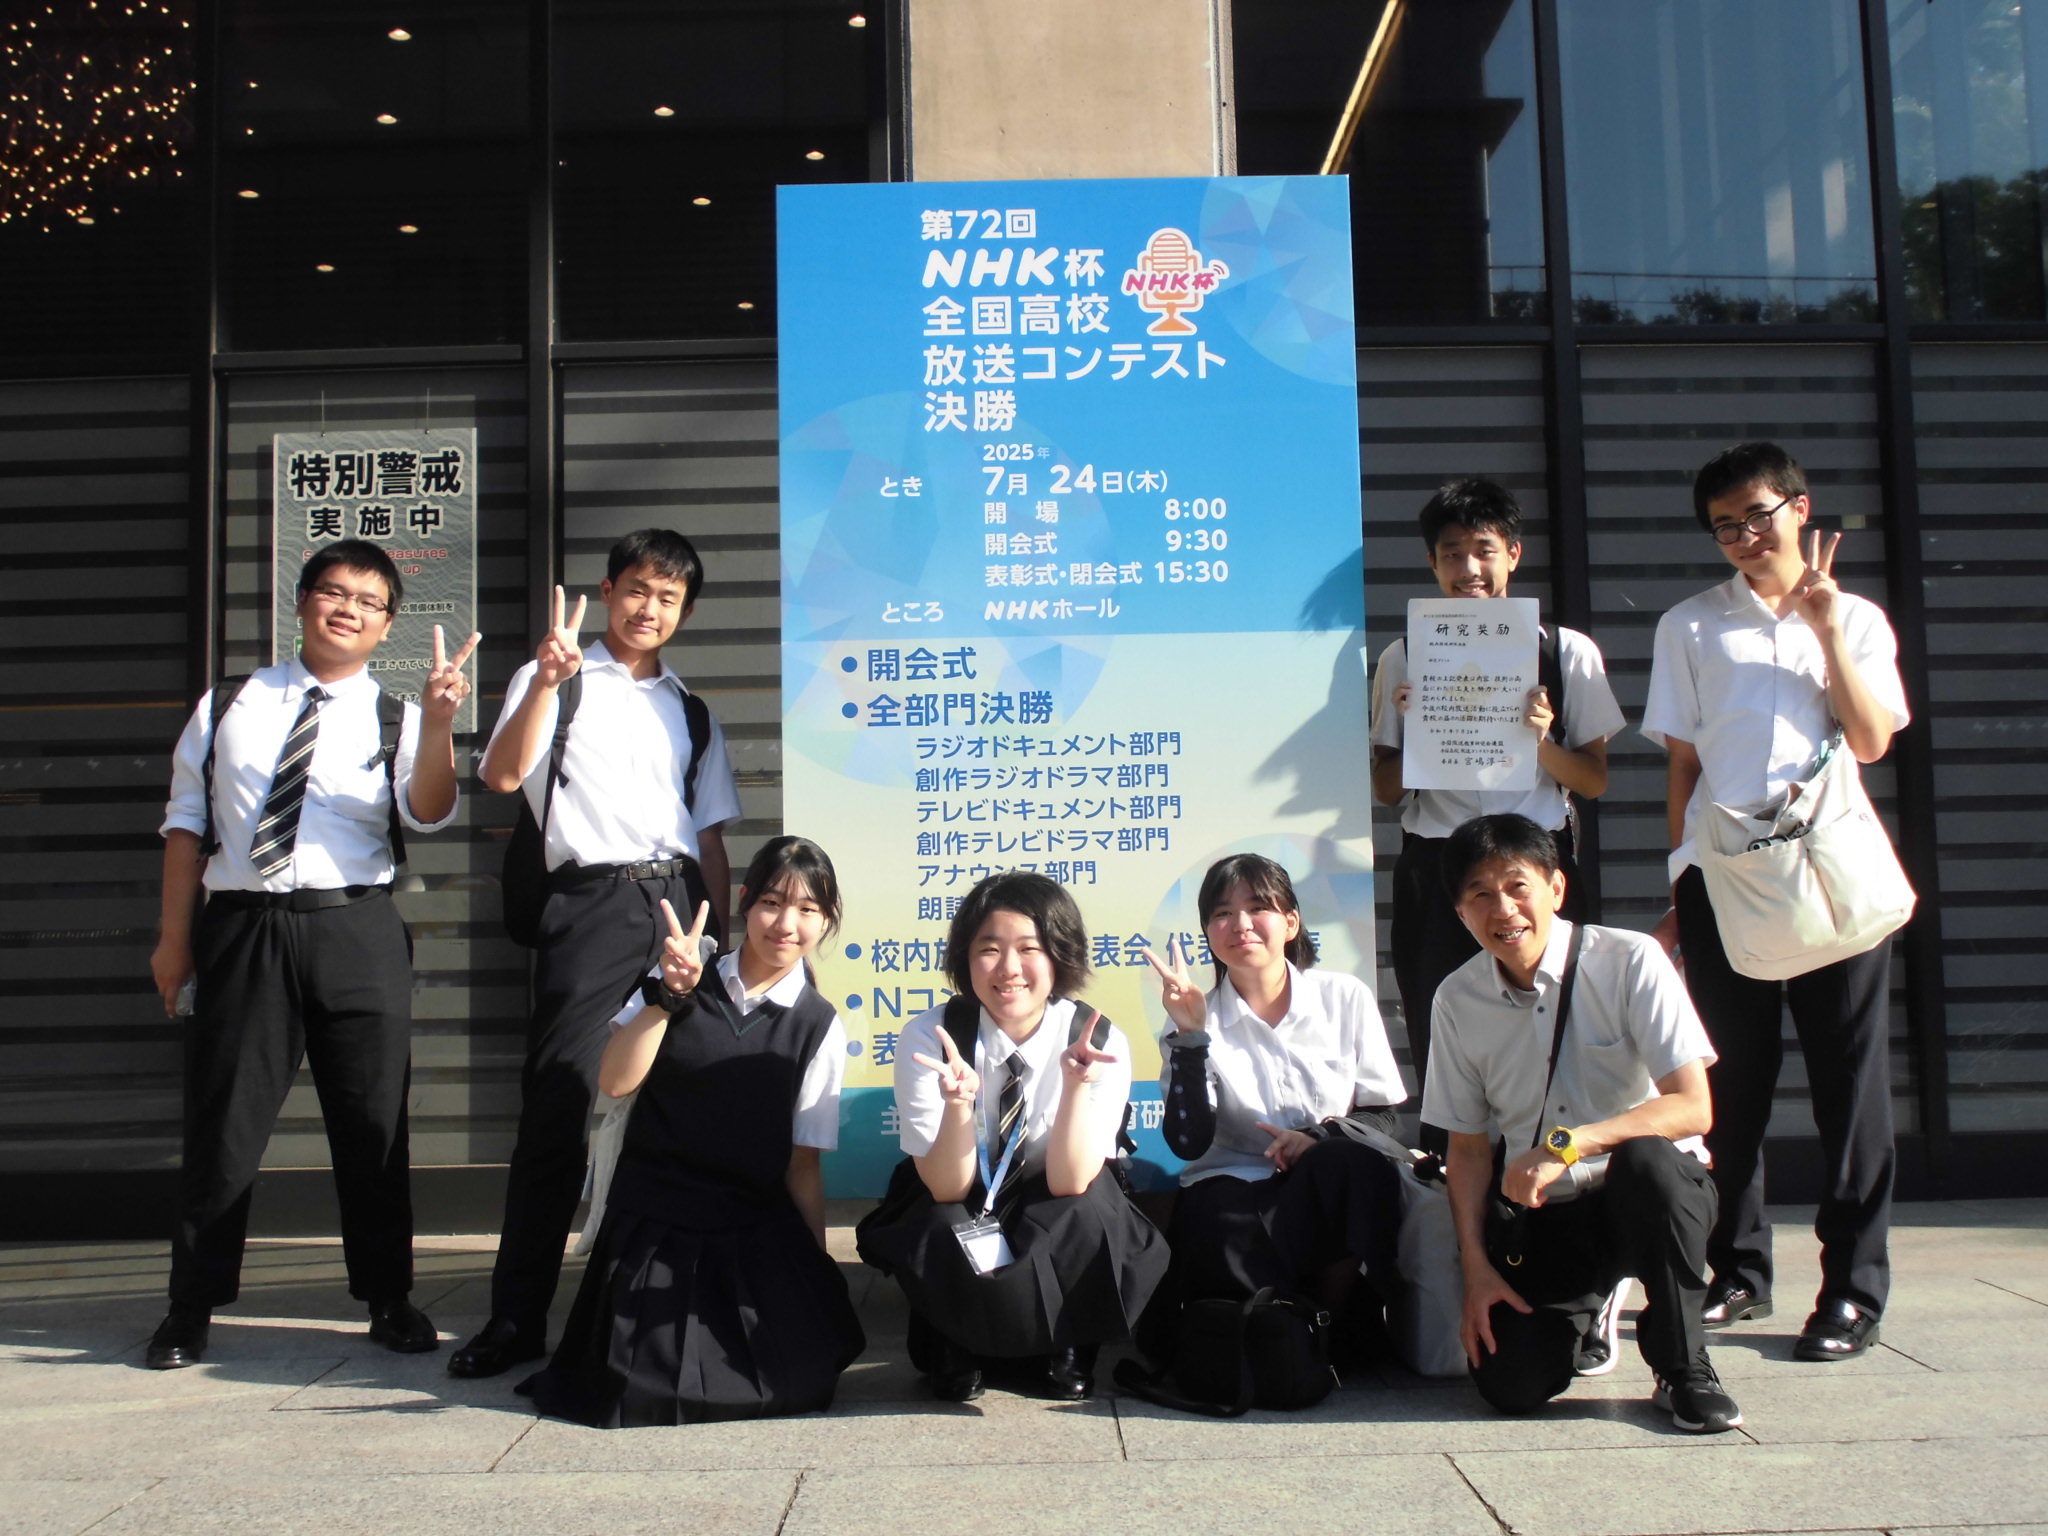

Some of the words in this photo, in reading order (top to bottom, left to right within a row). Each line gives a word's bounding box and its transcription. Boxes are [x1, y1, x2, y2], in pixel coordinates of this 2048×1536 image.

[921, 208, 1037, 241] 第72回
[922, 247, 1105, 288] NHK杯
[1125, 272, 1215, 292] NHK杯
[922, 293, 1110, 336] 全国高校
[923, 341, 1226, 386] 放送コンテスト
[924, 390, 1017, 432] 決勝
[983, 443, 1051, 461] 2025年
[290, 450, 462, 498] 特別警戒
[880, 476, 923, 497] とき
[982, 466, 1028, 496] 7月
[1049, 464, 1168, 494] 24日(木)
[1164, 498, 1227, 520] 8:00
[985, 532, 1058, 555] 開会式
[1166, 529, 1228, 551] 9:30
[984, 562, 1143, 587] 表彰式・閉会式
[1154, 560, 1229, 583] 15:30
[881, 601, 945, 623] ところ
[984, 598, 1121, 621] NHKホール
[866, 645, 978, 681] 開会式
[866, 689, 1055, 729] 全部門決勝
[914, 731, 1183, 760] ラジオドキュメント部門
[914, 764, 1170, 793] 創作ラジオドラマ部門
[916, 796, 1183, 823] テレビドキュメント部門
[916, 828, 1170, 856] 創作テレビドラマ部門
